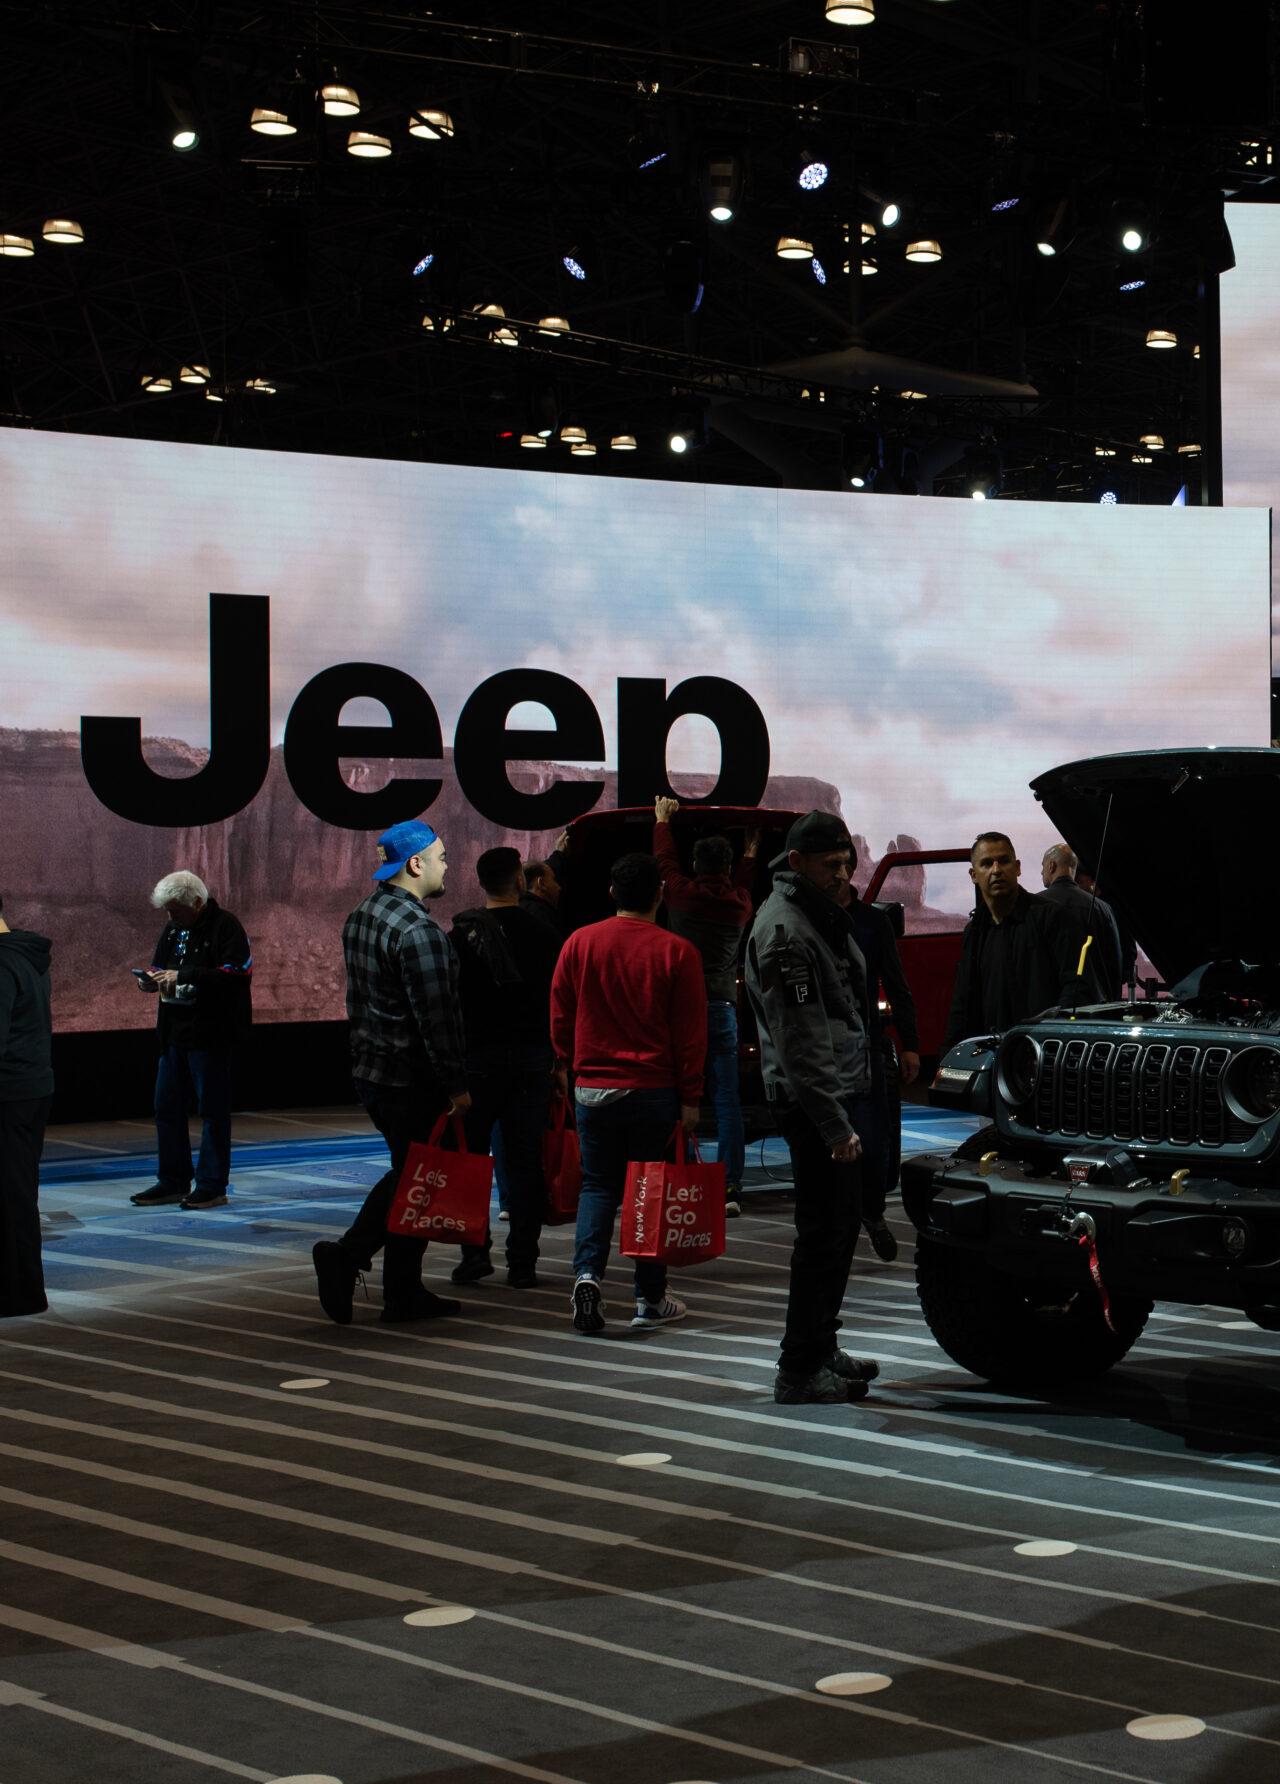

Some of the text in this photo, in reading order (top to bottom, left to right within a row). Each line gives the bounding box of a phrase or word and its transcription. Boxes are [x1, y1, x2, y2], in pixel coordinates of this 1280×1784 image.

[81, 593, 771, 831] Jeep
[407, 1185, 431, 1207] Go
[400, 1207, 467, 1232] Places
[634, 1175, 648, 1244] New York
[665, 1205, 697, 1226] Go
[664, 1228, 712, 1248] Places
